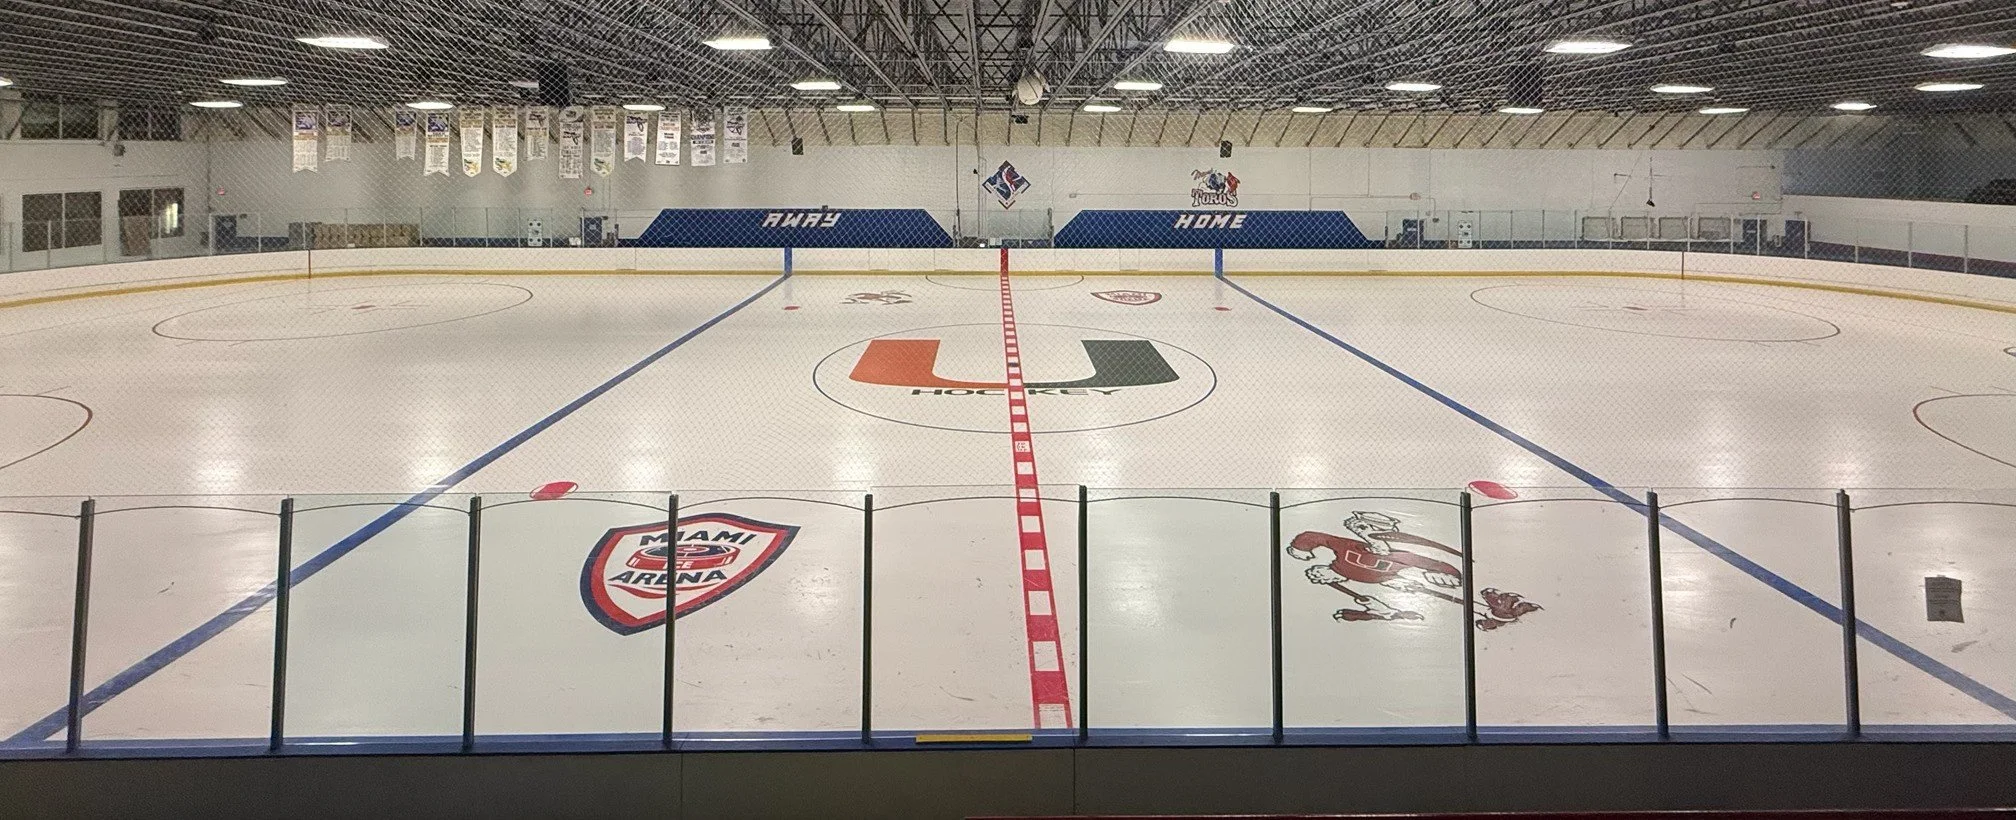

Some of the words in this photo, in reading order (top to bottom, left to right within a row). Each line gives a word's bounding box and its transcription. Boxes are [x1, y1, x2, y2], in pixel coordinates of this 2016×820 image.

[762, 212, 841, 228] AWAY
[1173, 214, 1248, 229] HOME
[849, 339, 1180, 388] U
[639, 530, 757, 546] MIAMI
[607, 569, 728, 585] ARENA
